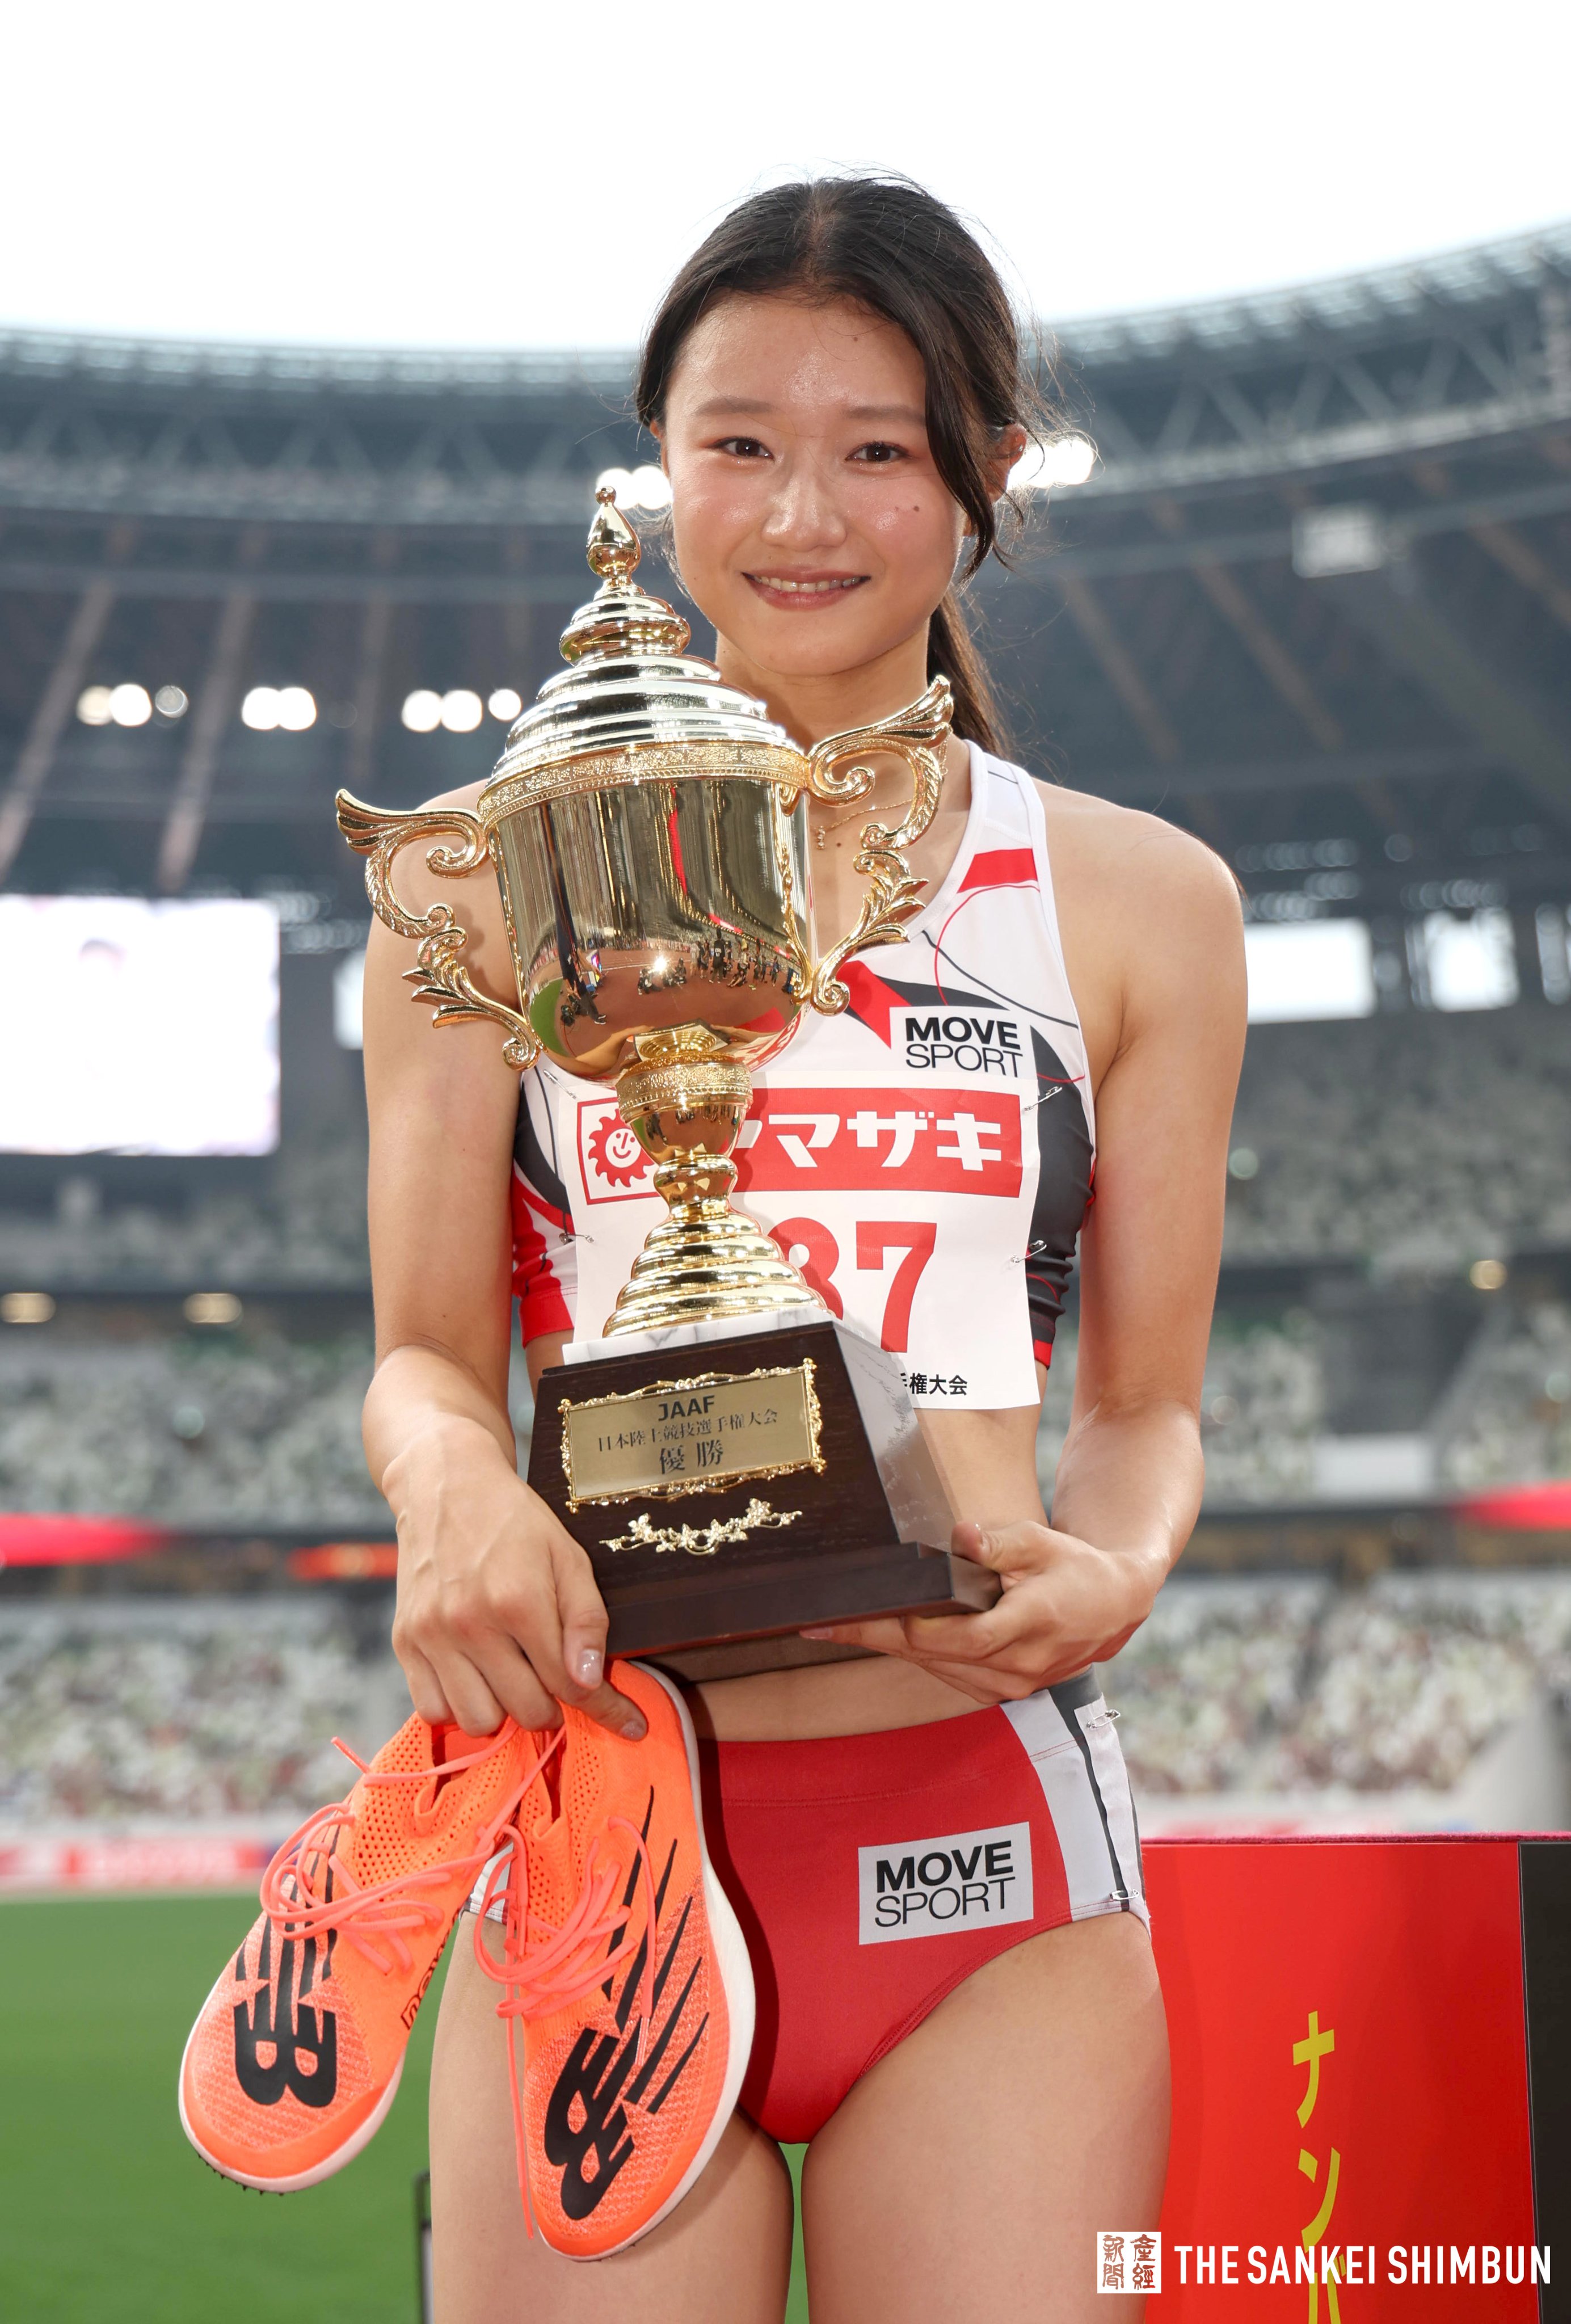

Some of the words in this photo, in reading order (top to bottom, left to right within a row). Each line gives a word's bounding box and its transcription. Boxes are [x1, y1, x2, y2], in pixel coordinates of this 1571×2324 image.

[905, 1016, 1021, 1050] MOVE
[905, 1043, 1024, 1078] SPORT
[658, 1395, 715, 1421] JAAF
[597, 1408, 778, 1452] 日本陸上競技選手権大会
[659, 1439, 724, 1475] 優勝
[875, 1839, 1014, 1894] MOVE
[874, 1876, 1016, 1928] SPORT
